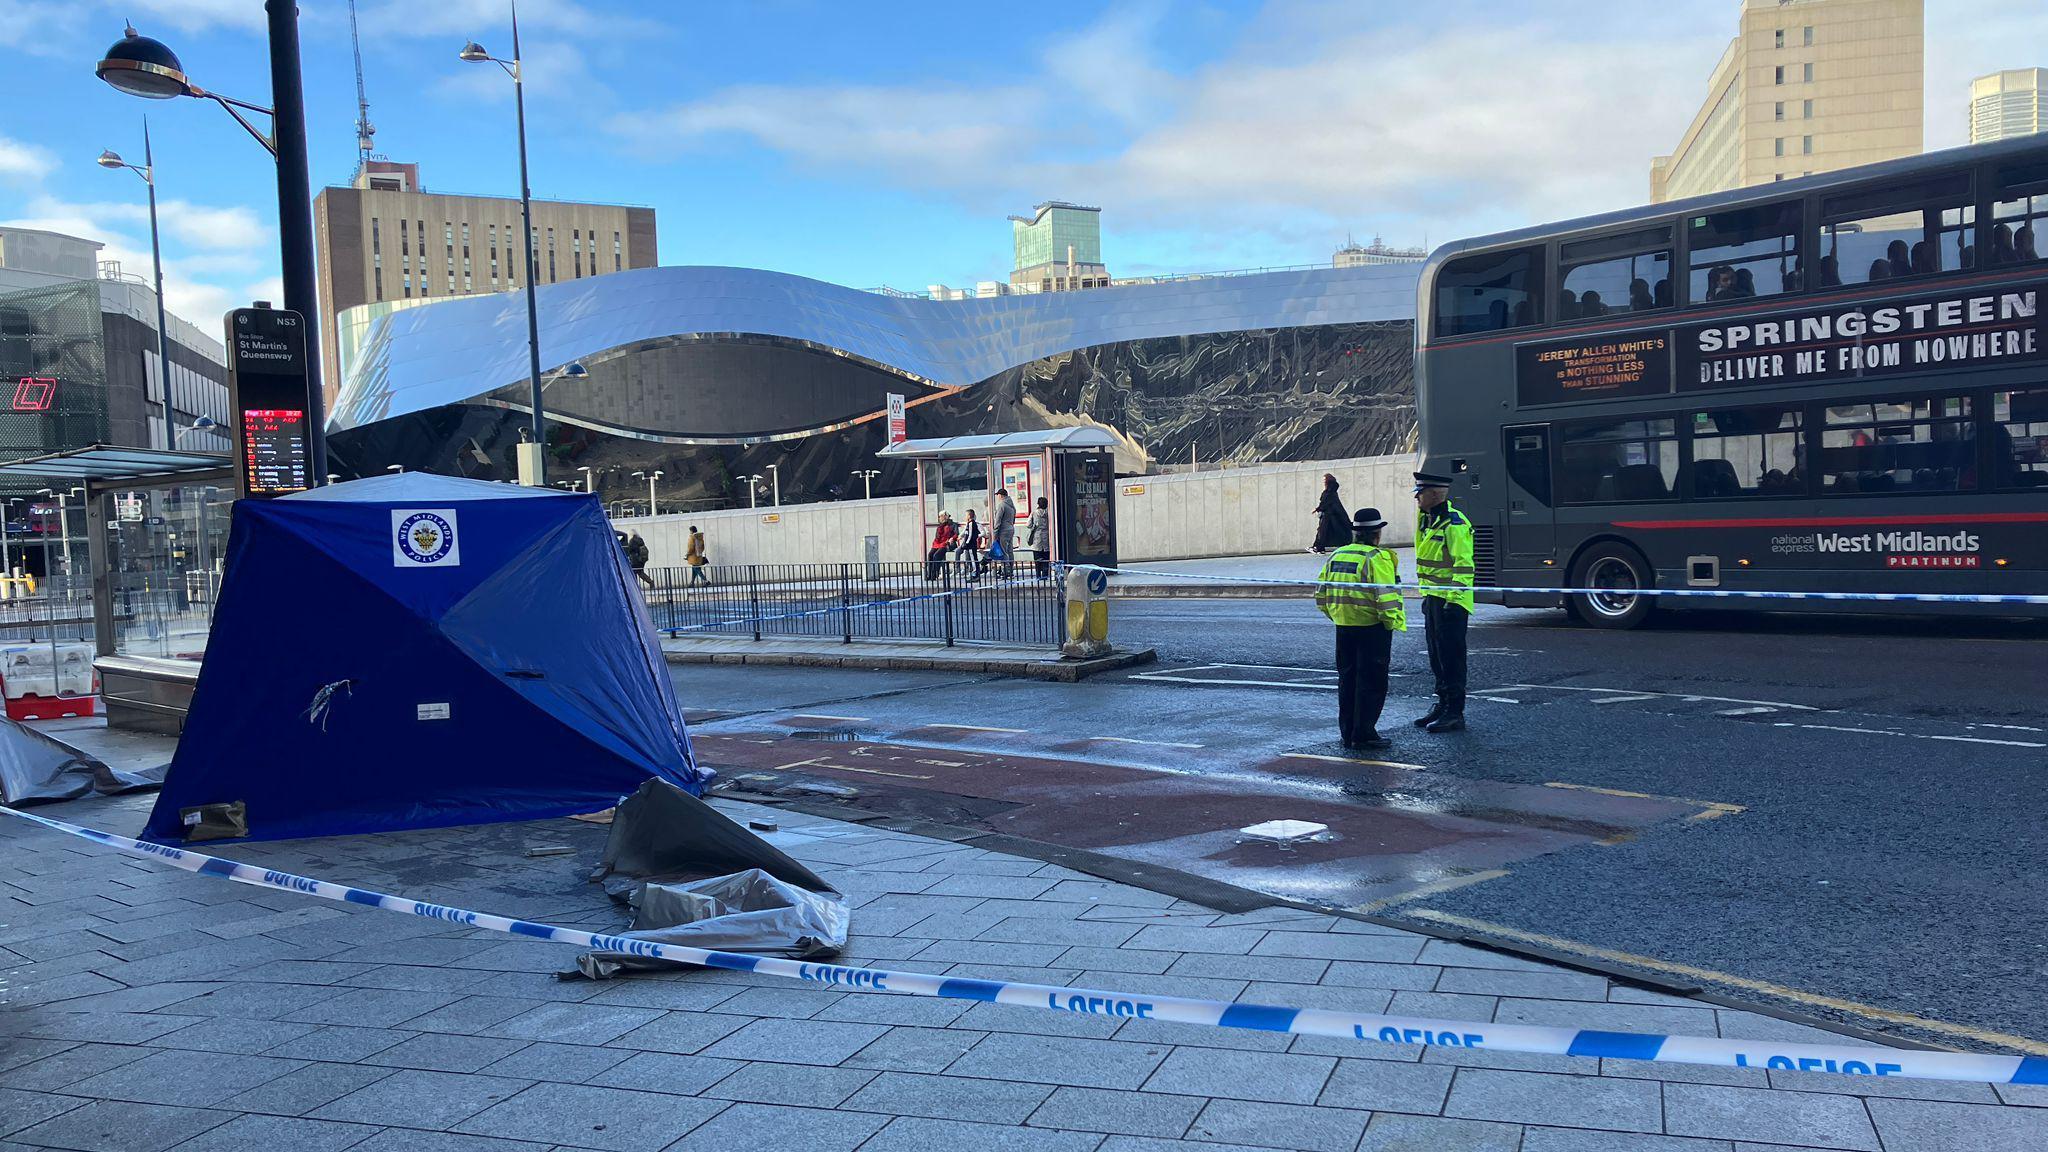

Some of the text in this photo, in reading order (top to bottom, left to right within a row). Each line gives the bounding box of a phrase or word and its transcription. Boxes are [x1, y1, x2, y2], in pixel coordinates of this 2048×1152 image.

[276, 317, 296, 326] NS3
[1698, 291, 2037, 352] SPRINGSTEEN
[240, 340, 288, 351] St Martin's
[1582, 343, 1616, 356] ALLEN
[1618, 339, 1665, 352] WHITE'S
[240, 350, 292, 361] Queensway
[1564, 353, 1637, 367] TRANSFORMATION
[1700, 328, 2037, 383] DELIVER ME FROM NOWHERE
[1557, 360, 1645, 379] IS NOTHING LESS
[1562, 379, 1583, 388] THAN
[400, 514, 451, 540] WEST MIDLANDS
[1771, 533, 1815, 545] national
[1816, 530, 1980, 553] West Midlands
[1771, 544, 1815, 555] express
[408, 552, 444, 562] POLICE
[1890, 557, 1976, 566] PLATINUM
